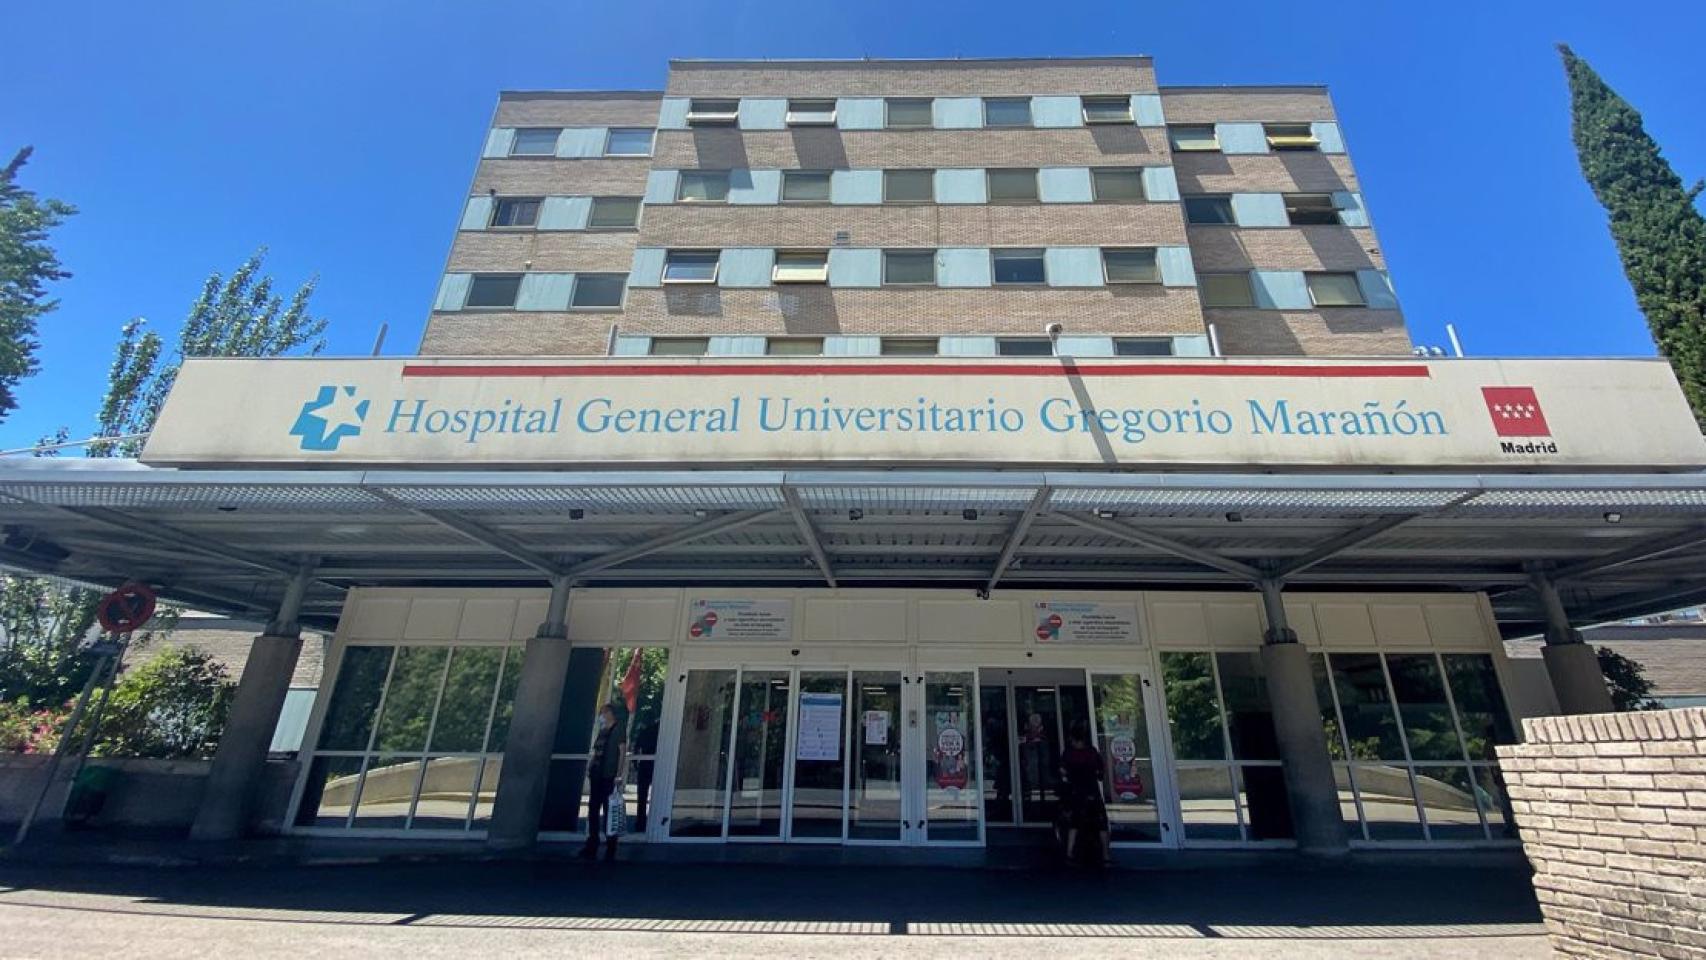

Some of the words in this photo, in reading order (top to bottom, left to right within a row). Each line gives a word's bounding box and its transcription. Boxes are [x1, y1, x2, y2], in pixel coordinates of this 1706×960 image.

[383, 397, 562, 443] Hospital
[576, 398, 739, 434] General
[758, 397, 1024, 433] Universitario
[1039, 398, 1233, 443] Gregorio
[1249, 399, 1448, 436] Marañón
[1500, 442, 1558, 454] Madrid
